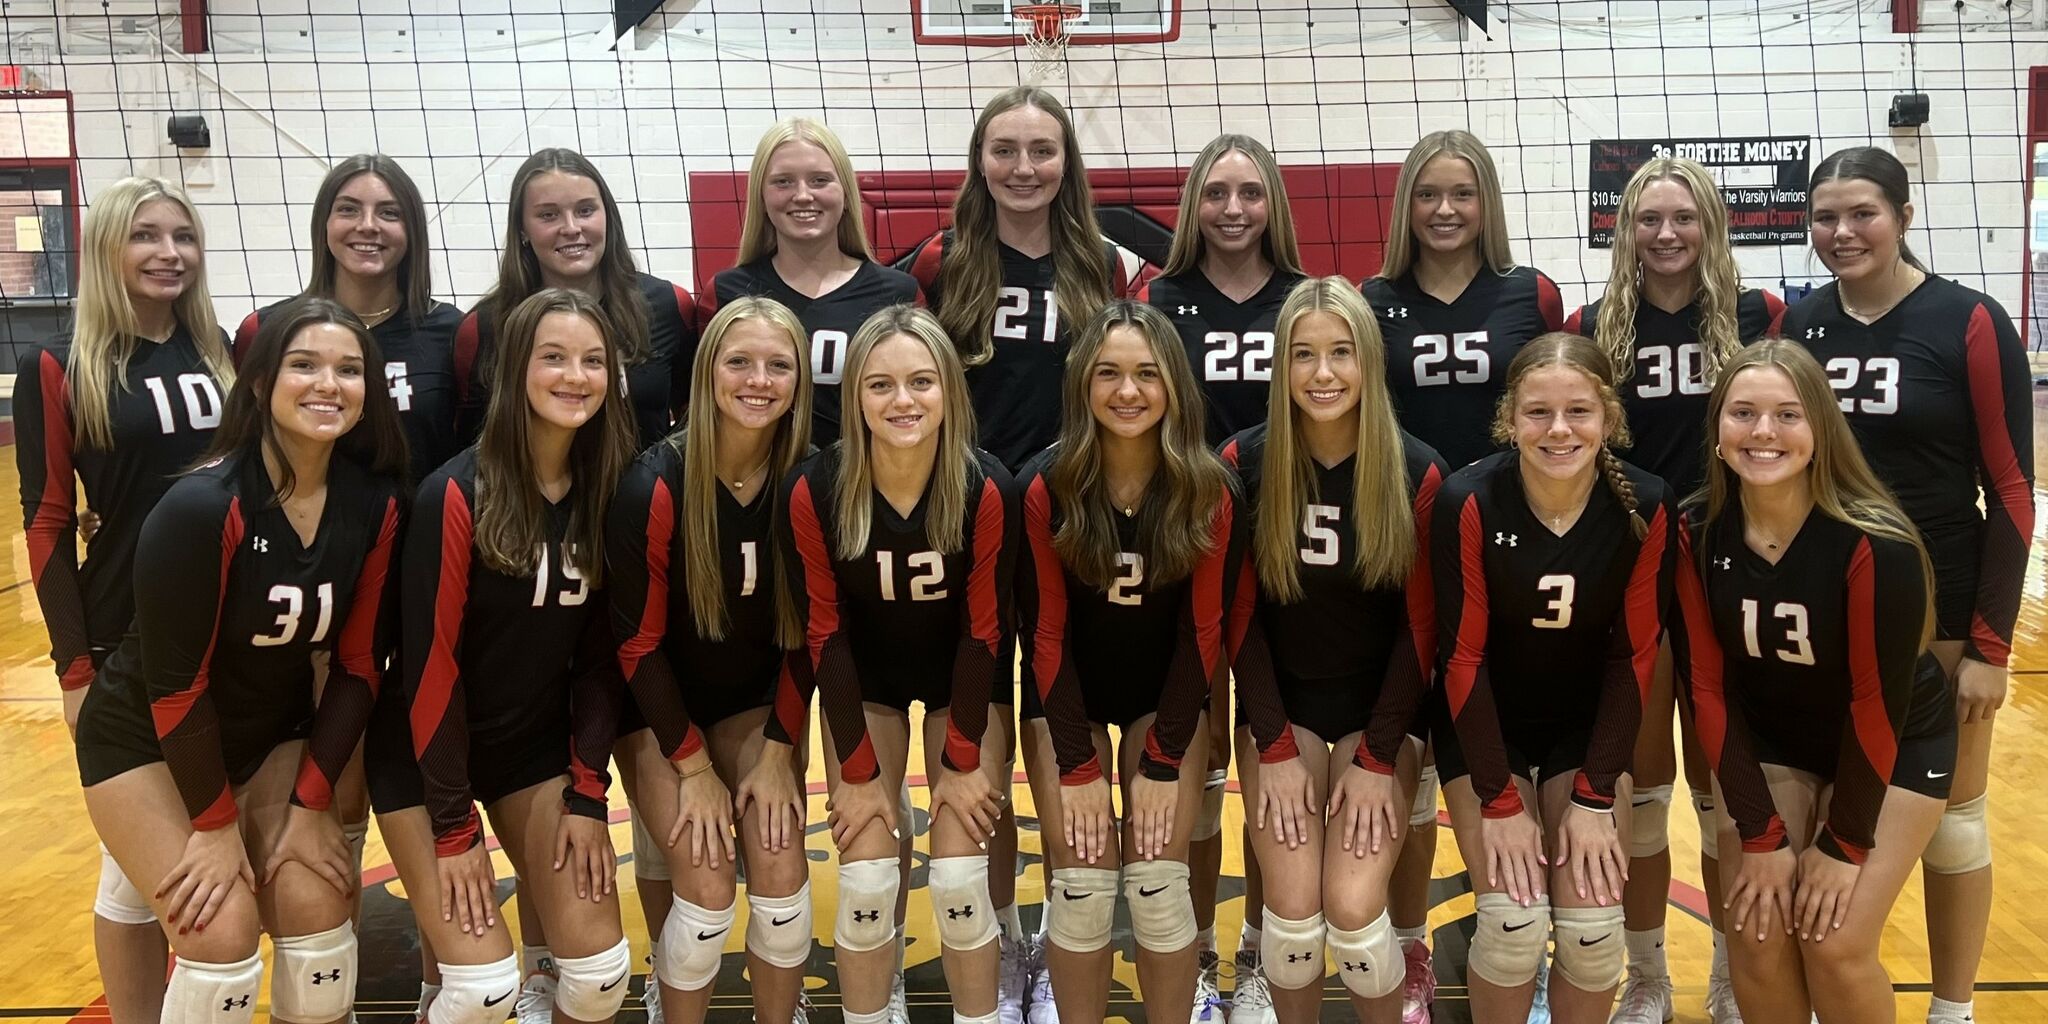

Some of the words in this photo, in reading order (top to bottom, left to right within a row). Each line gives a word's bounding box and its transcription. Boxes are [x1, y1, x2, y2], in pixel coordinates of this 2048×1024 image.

[1744, 141, 1807, 161] MONEY
[1592, 191, 1609, 207] $10
[1610, 191, 1622, 206] for
[1739, 189, 1768, 207] Varsity
[1770, 188, 1806, 203] Warriors
[993, 286, 1059, 343] 21
[1204, 331, 1276, 382] 22
[1412, 330, 1491, 387] 25
[1636, 343, 1714, 399] 30
[144, 373, 223, 435] 10
[1825, 357, 1900, 415] 23
[1300, 503, 1341, 566] 5
[740, 541, 757, 596] 1
[876, 550, 948, 601] 12
[1107, 552, 1144, 606] 2
[251, 582, 333, 647] 31
[1531, 574, 1576, 629] 3
[1741, 598, 1816, 666] 13
